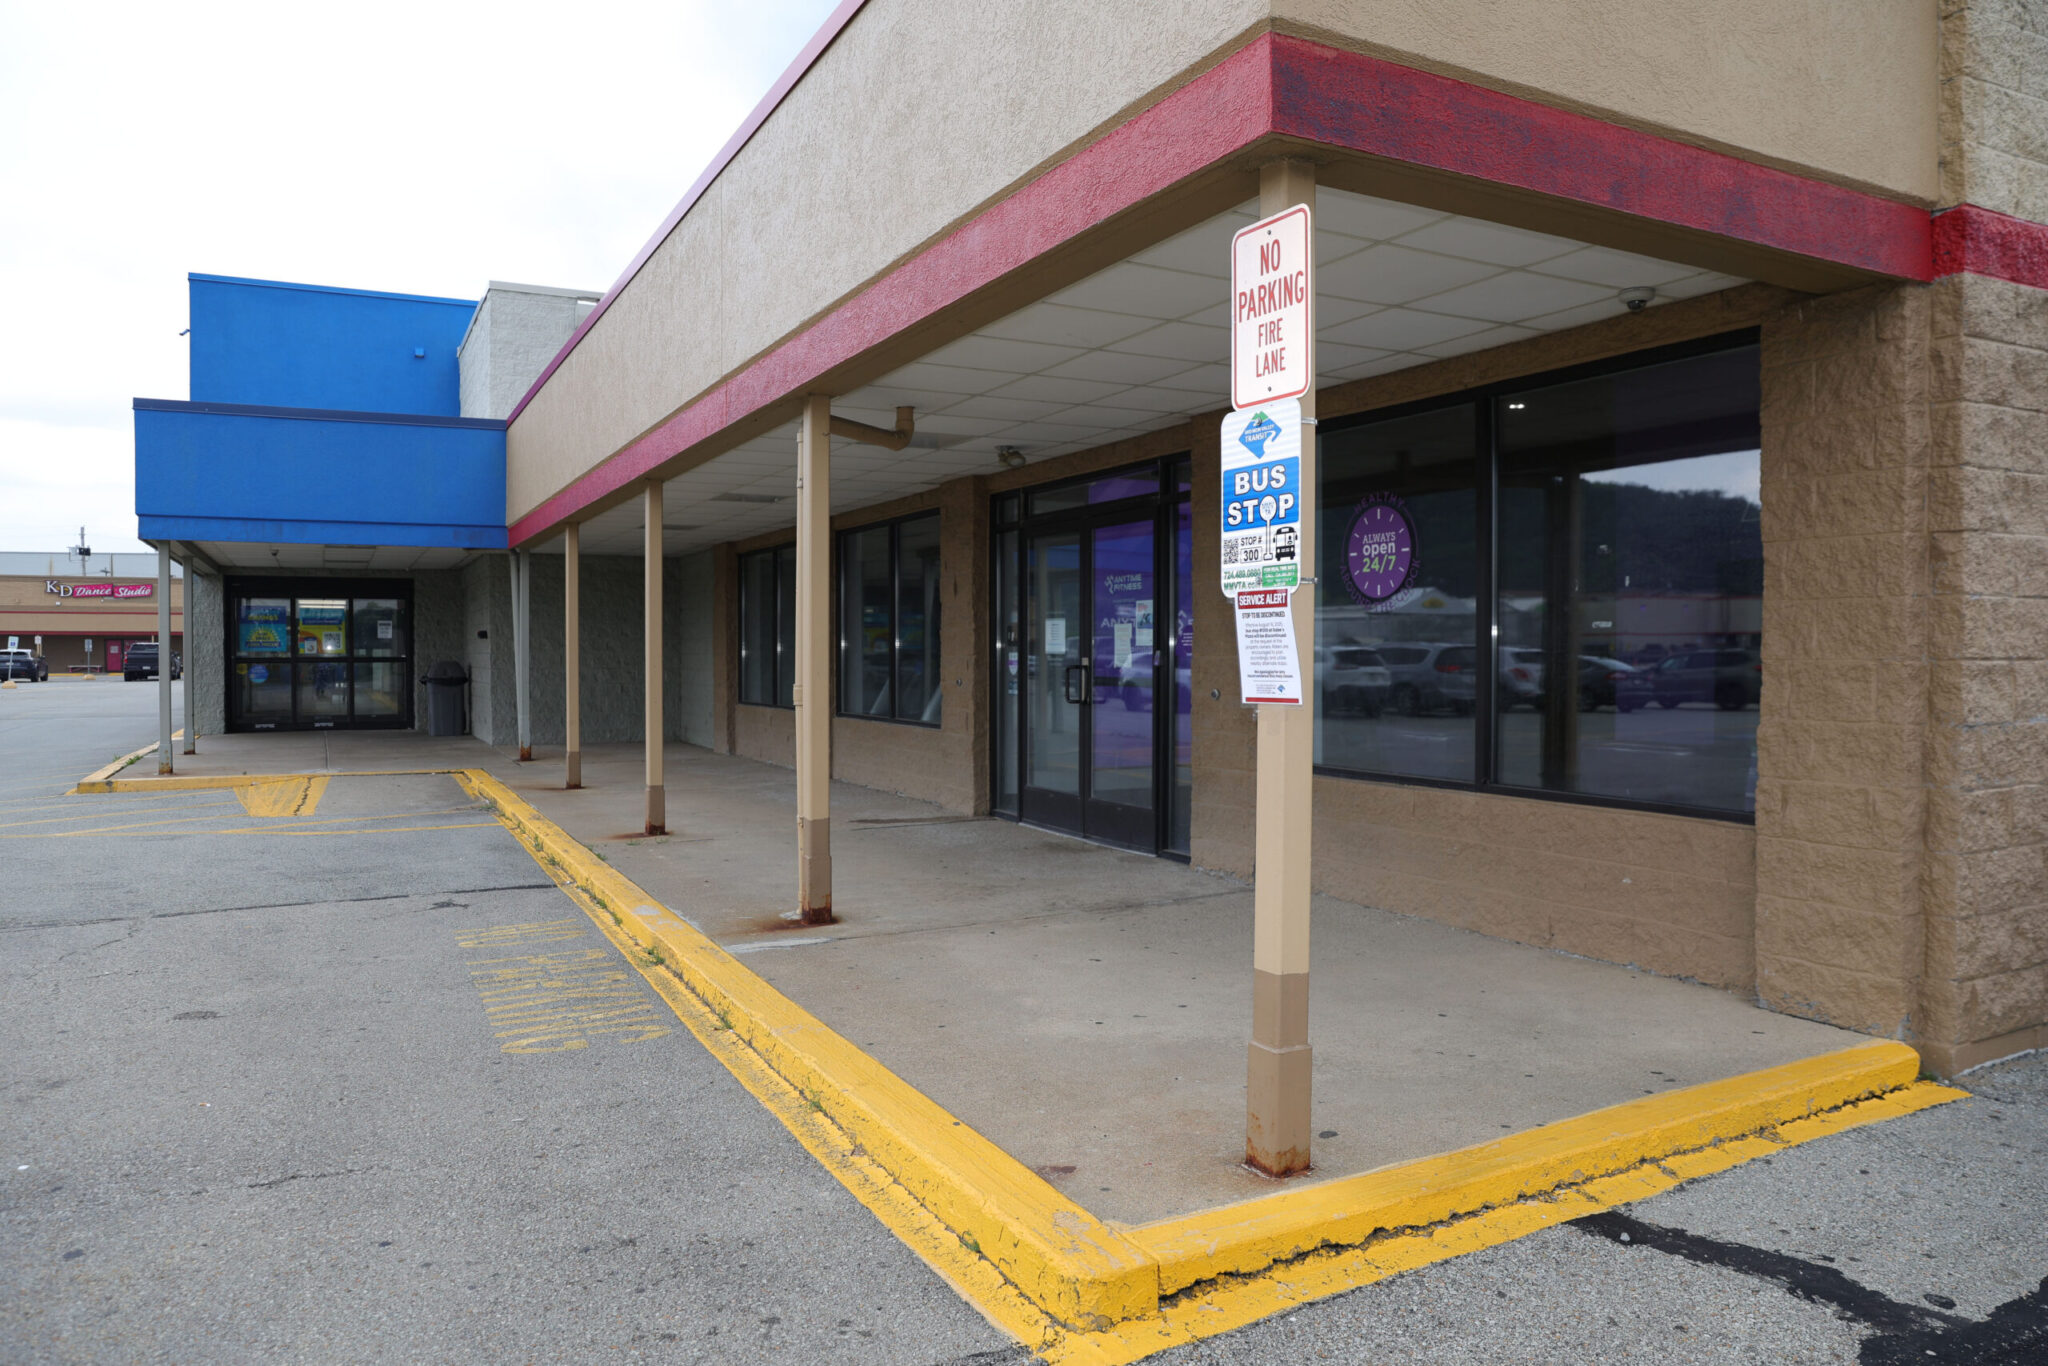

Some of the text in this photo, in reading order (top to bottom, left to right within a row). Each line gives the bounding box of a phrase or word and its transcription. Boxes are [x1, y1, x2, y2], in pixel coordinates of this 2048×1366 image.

[1260, 239, 1281, 276] NO
[1238, 271, 1305, 323] PARKING
[1258, 318, 1284, 348] FIRE
[1256, 347, 1286, 378] LANE
[1245, 432, 1268, 443] TRANSIT
[1234, 464, 1286, 496] BUS
[1227, 492, 1295, 526] STOP
[1240, 536, 1257, 546] STOP
[1362, 531, 1396, 545] ALWAYS
[1243, 549, 1259, 562] 300
[1362, 542, 1396, 558] open
[1362, 554, 1397, 574] 24/7
[1113, 574, 1142, 583] ANYTIME
[46, 580, 152, 597] KD Dance Studio
[1113, 582, 1142, 592] FITNESS
[1239, 592, 1286, 606] SERVICE ALERT
[1100, 617, 1137, 629] ANYT
[466, 948, 673, 1055] PARKING
